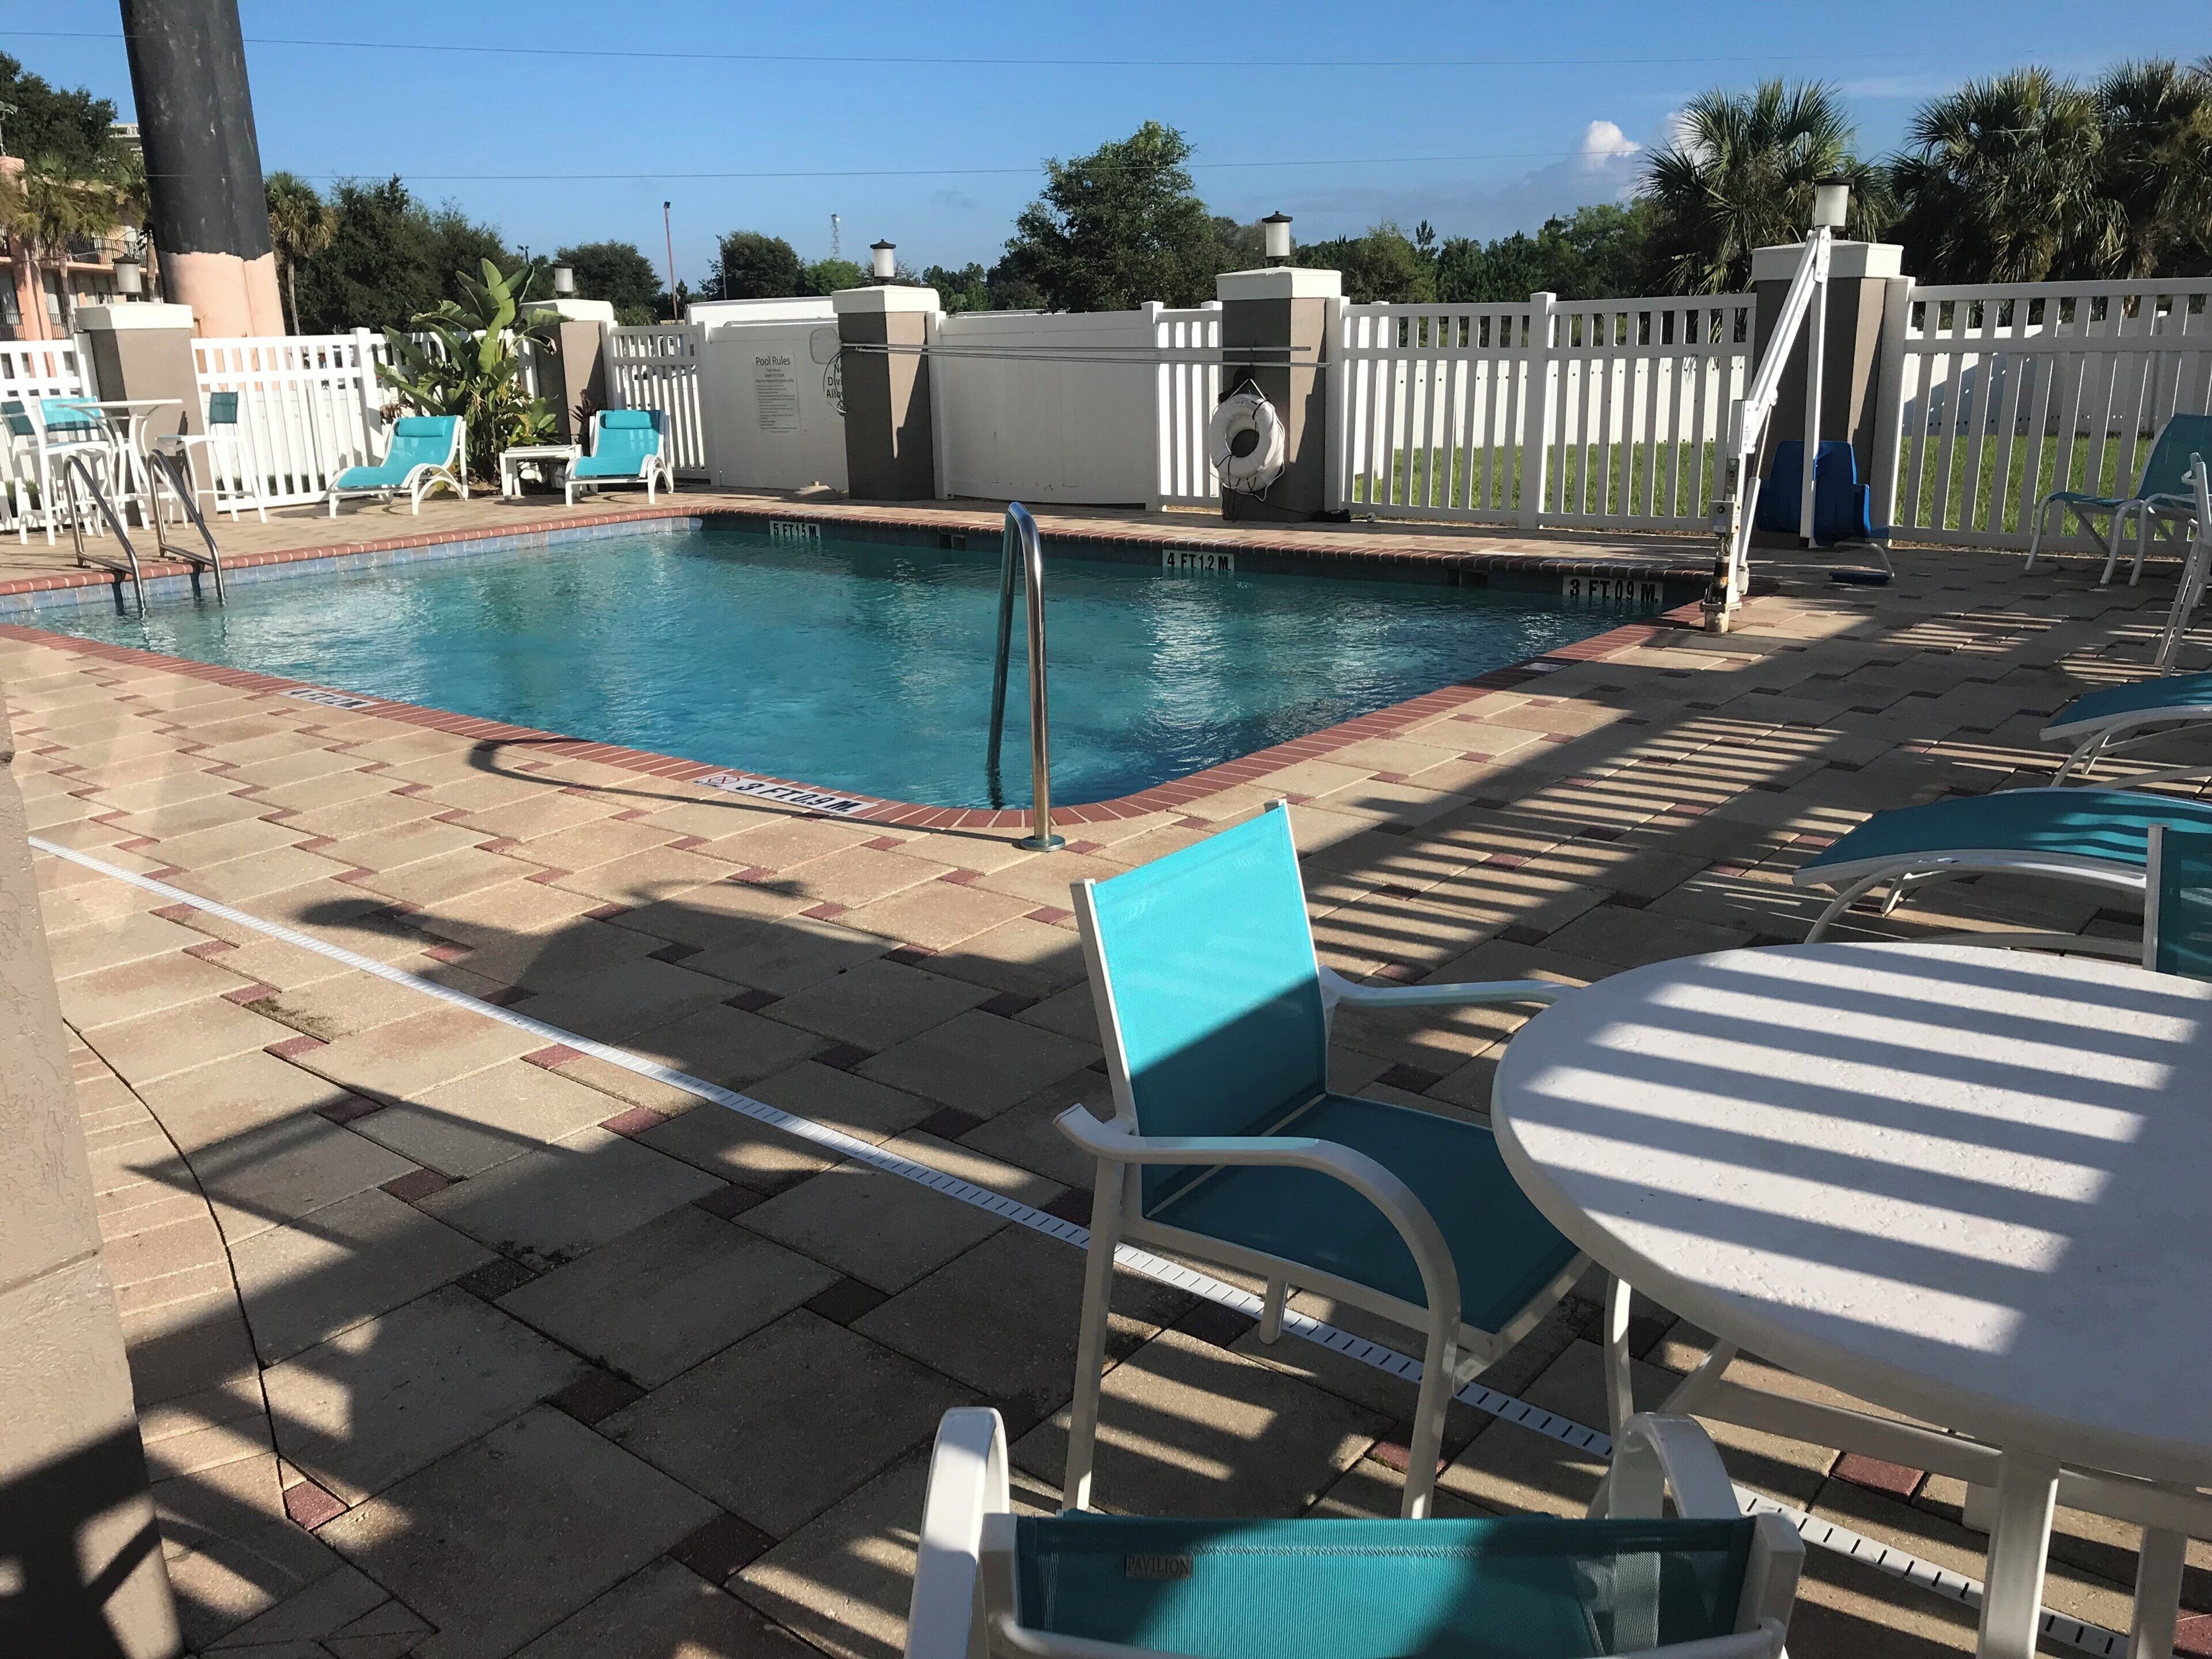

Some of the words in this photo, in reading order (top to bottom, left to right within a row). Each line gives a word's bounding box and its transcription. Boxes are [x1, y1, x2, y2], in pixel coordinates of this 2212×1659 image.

[756, 356, 770, 365] Pool
[772, 356, 790, 365] Rules
[834, 364, 842, 373] N
[826, 389, 843, 398] Allo
[773, 523, 779, 535] 5
[1167, 552, 1175, 567] 4
[1570, 579, 1580, 596] 3
[1127, 1557, 1190, 1574] PAVILION
